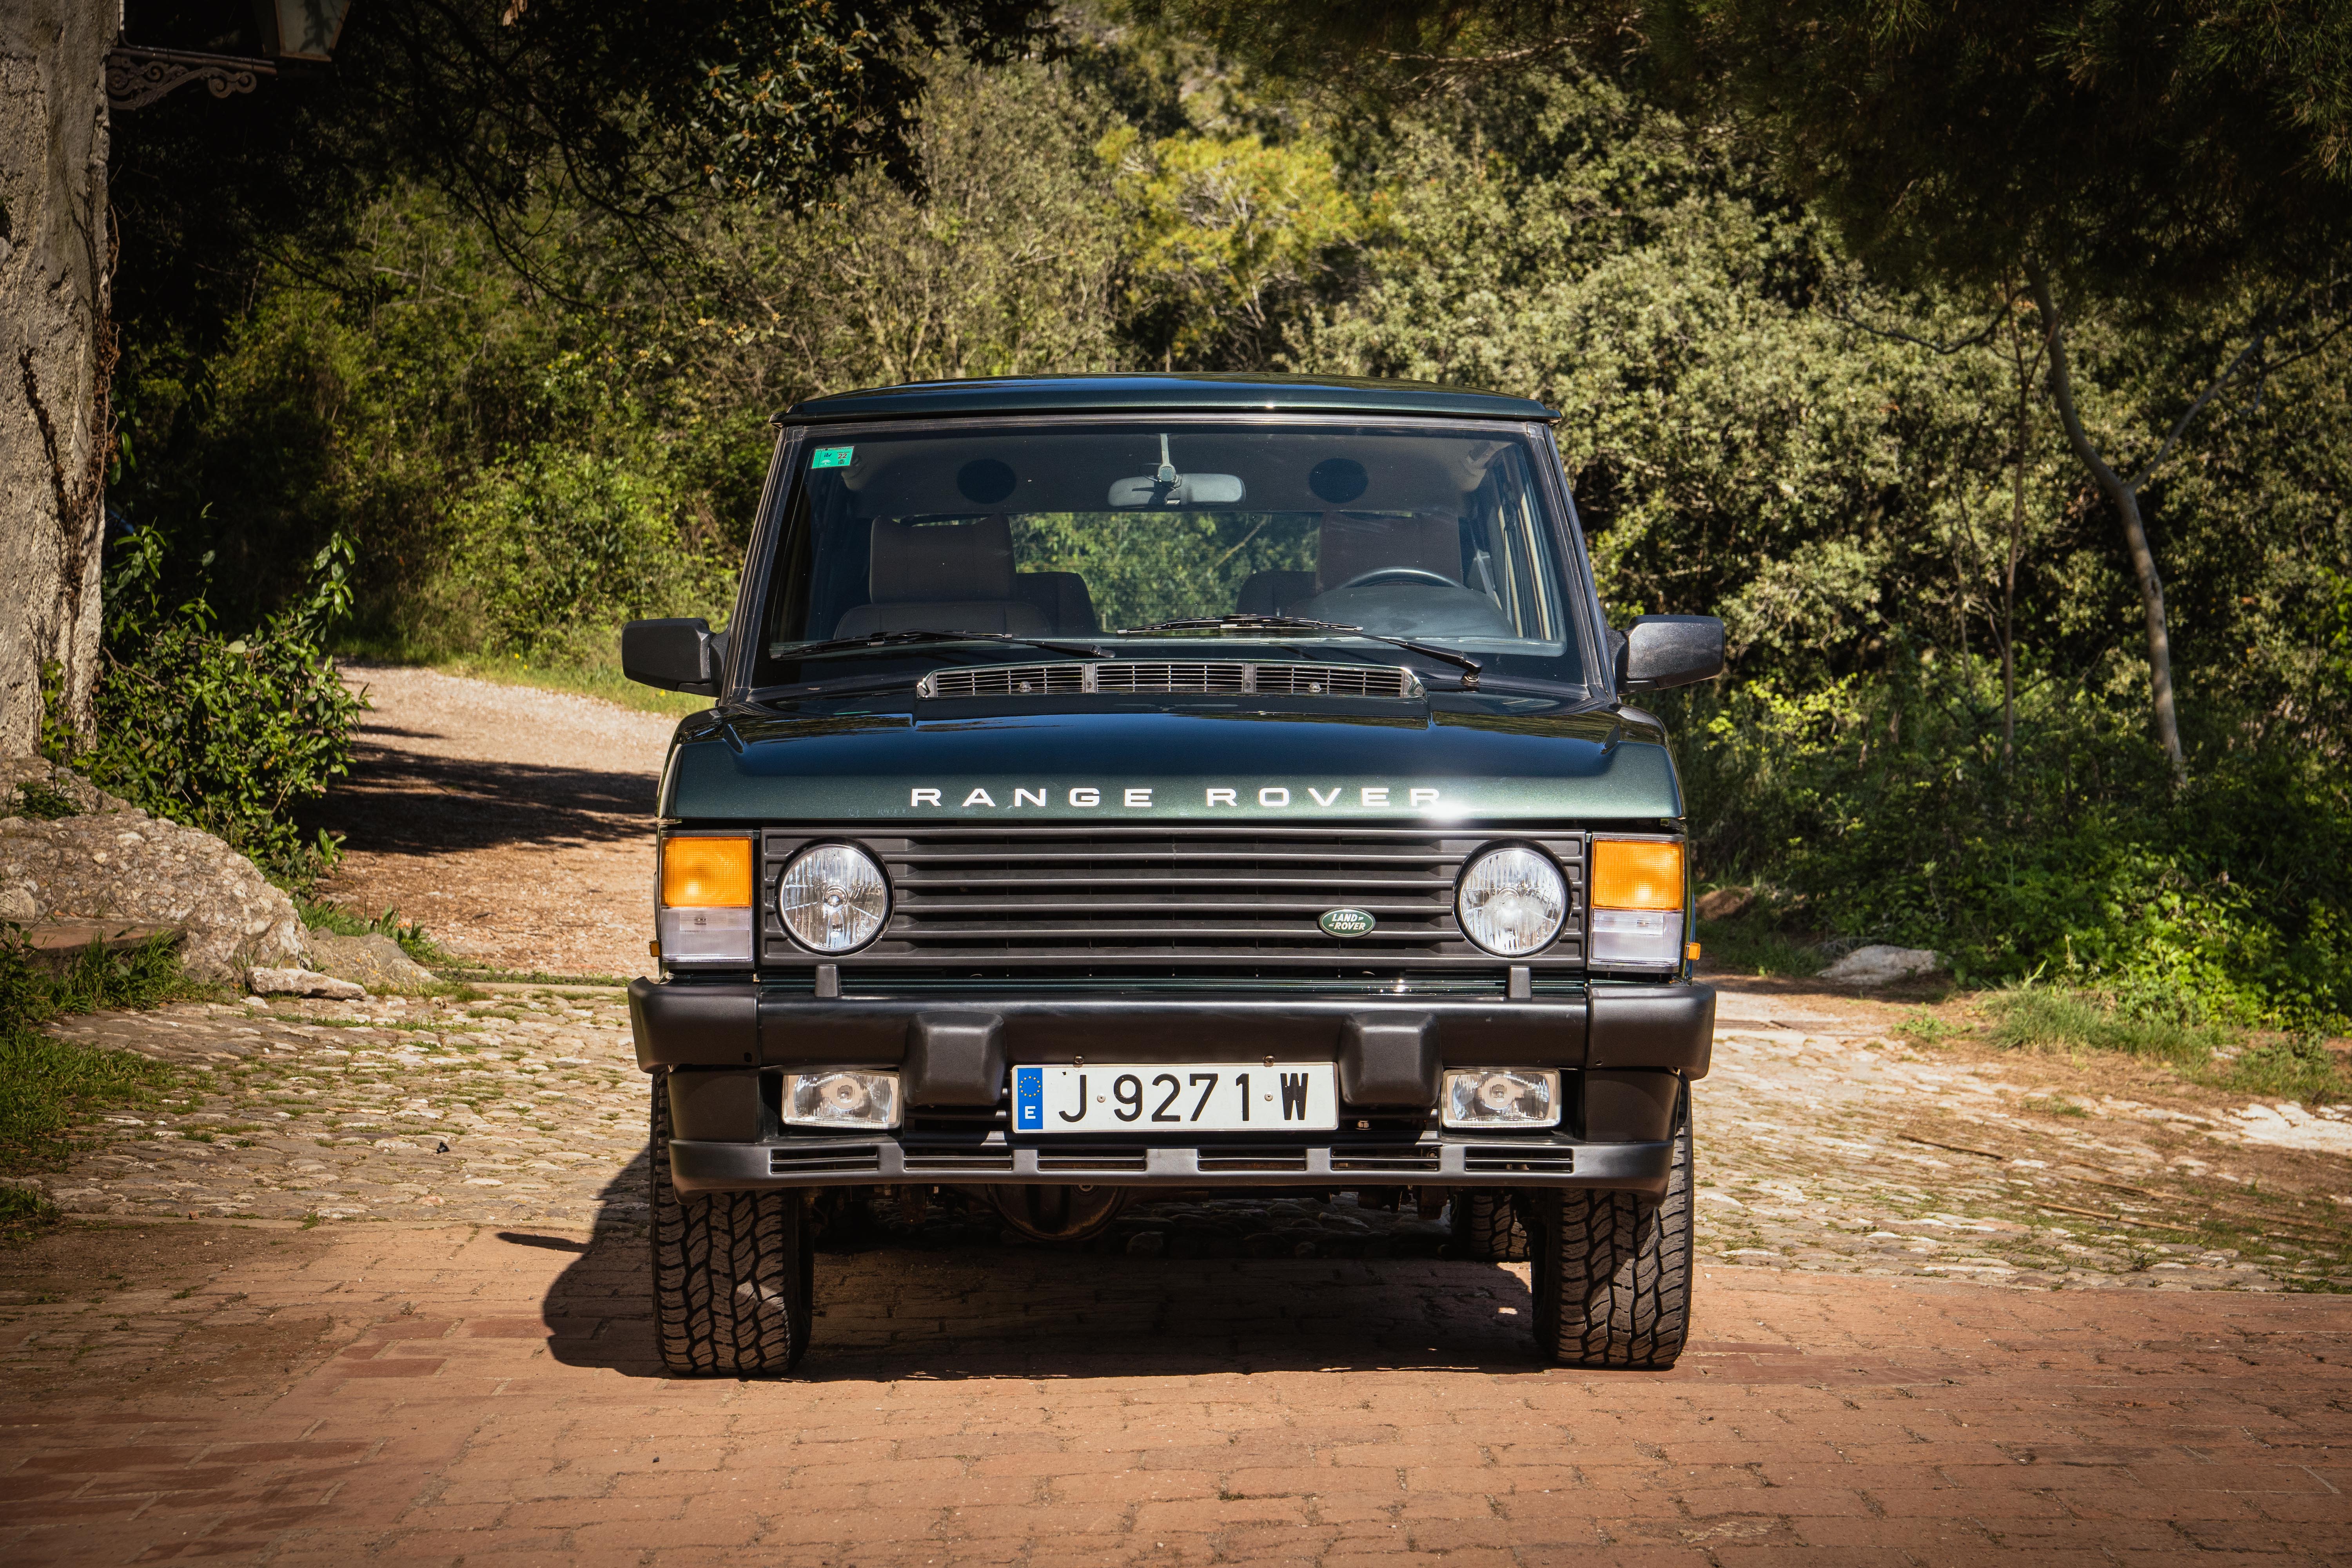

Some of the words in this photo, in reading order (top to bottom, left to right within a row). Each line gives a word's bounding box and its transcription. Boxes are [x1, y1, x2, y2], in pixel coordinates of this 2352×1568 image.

[911, 788, 1152, 807] RANGE
[1206, 788, 1440, 807] ROVER
[1332, 913, 1358, 922] LAND
[1059, 1074, 1087, 1123] J
[1113, 1073, 1250, 1122] 9271
[1280, 1073, 1309, 1121] W
[1025, 1106, 1036, 1119] E
